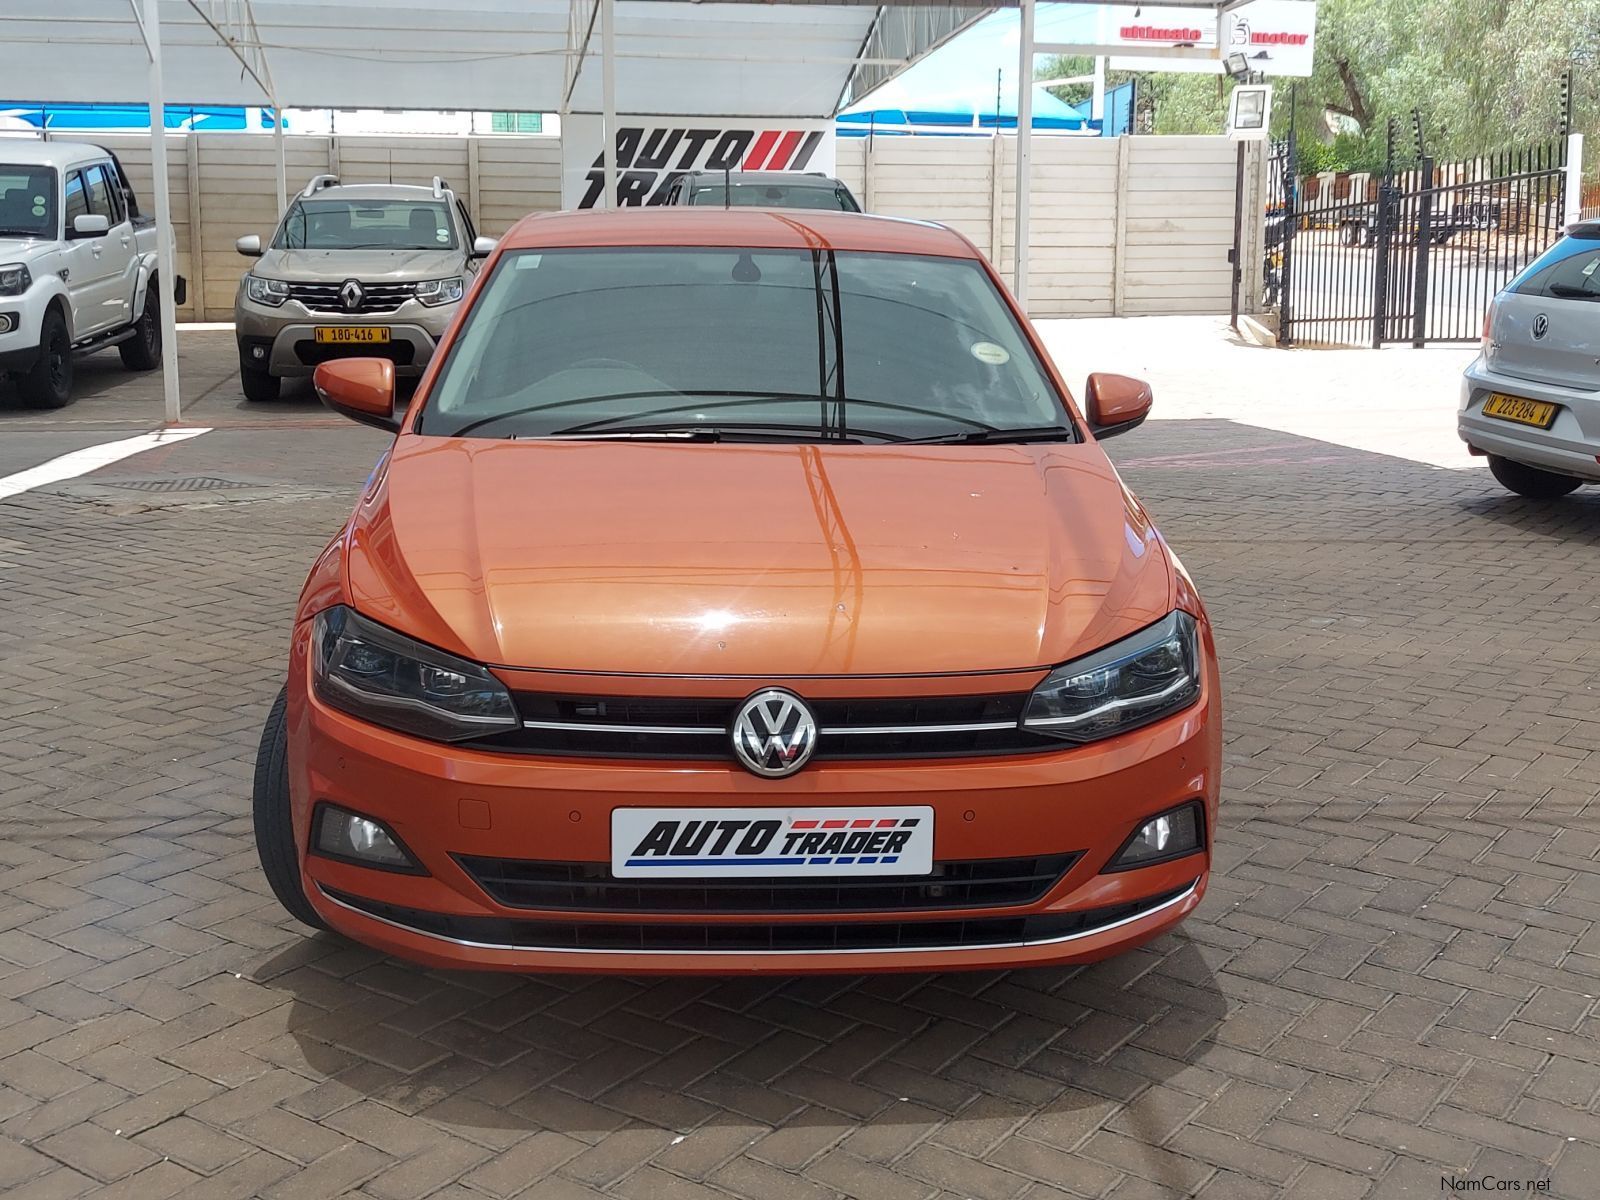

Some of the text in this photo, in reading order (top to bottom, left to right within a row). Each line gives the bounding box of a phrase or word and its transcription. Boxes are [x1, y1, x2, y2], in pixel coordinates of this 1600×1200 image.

[591, 128, 755, 170] AUTO
[317, 329, 387, 340] N 180-416 W
[1497, 398, 1537, 420] 223-284
[631, 821, 912, 856] AUTO TRADER
